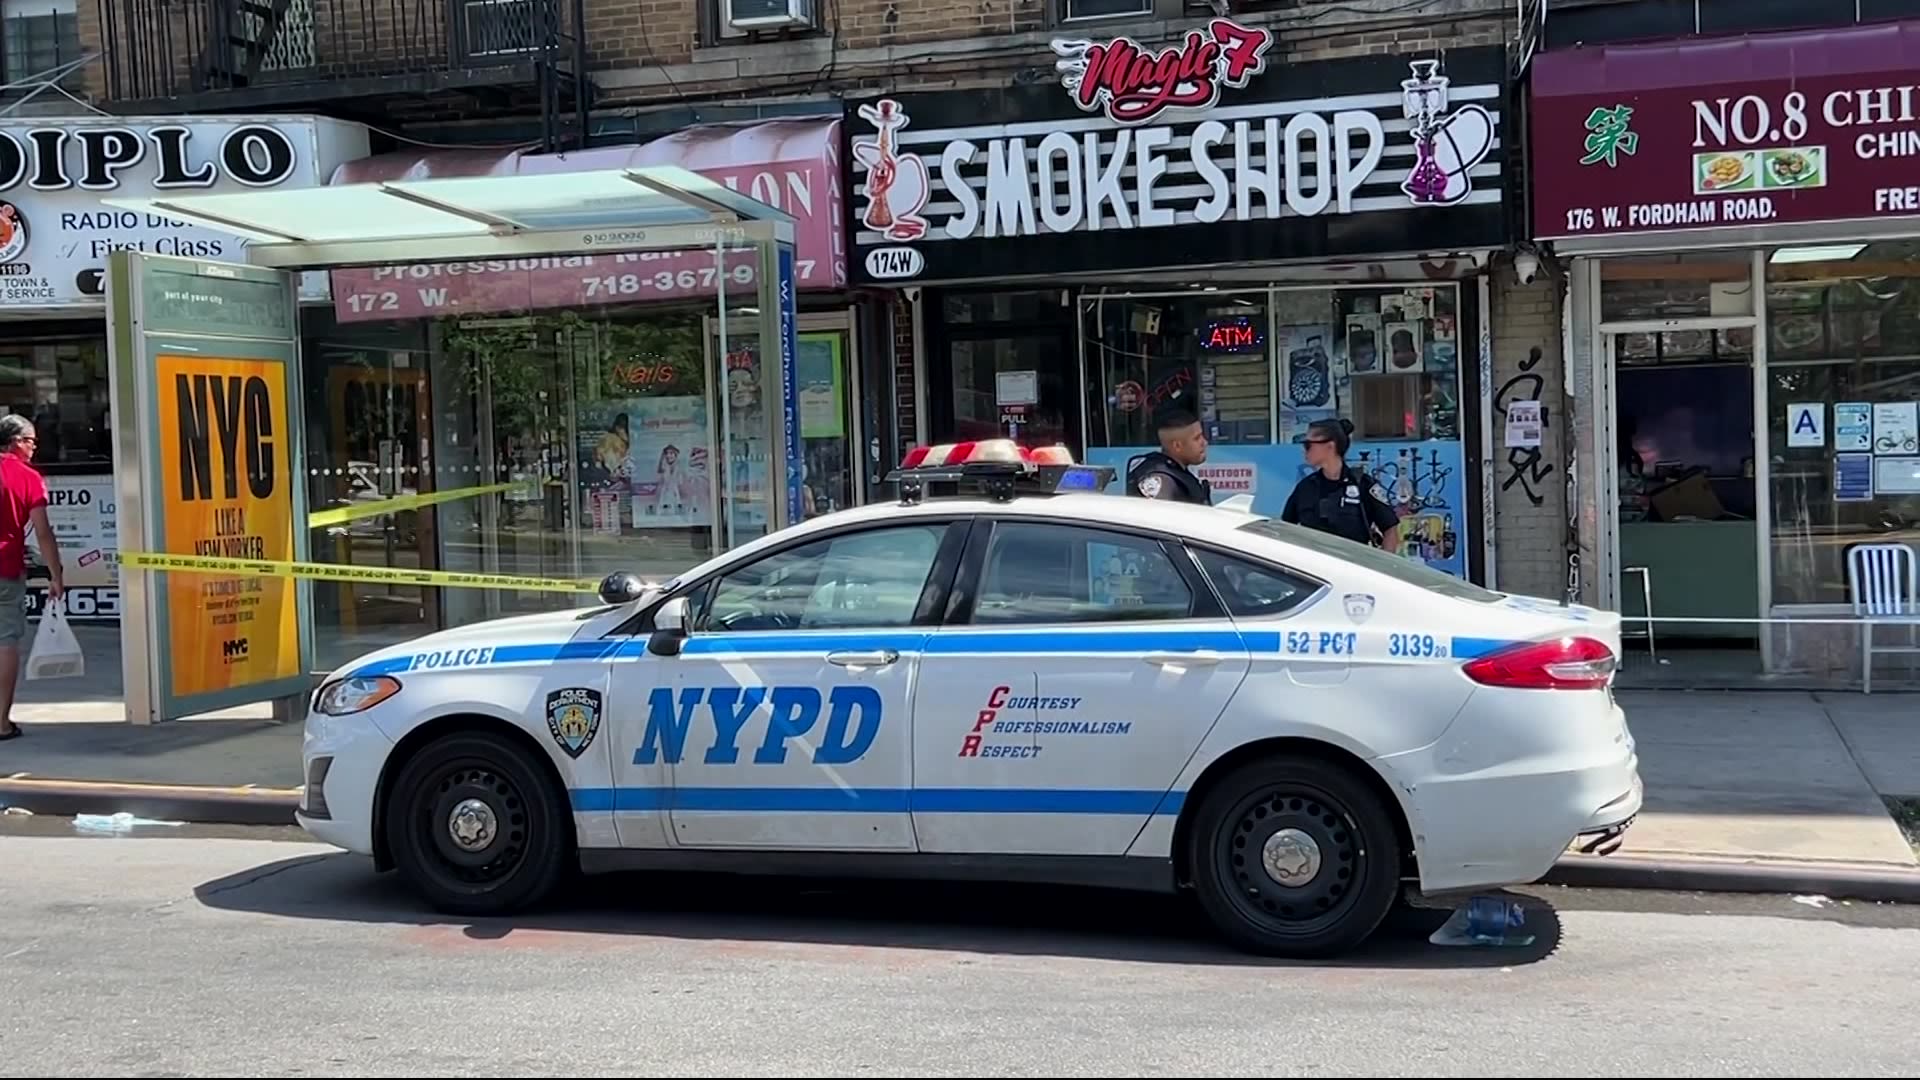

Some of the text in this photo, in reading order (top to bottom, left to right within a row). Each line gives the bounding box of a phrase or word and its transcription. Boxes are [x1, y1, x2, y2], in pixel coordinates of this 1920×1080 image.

[1072, 18, 1270, 118] Magic 7
[1691, 84, 1920, 150] NO.8 CHI
[1578, 103, 1640, 169] 第
[940, 110, 1386, 239] SMOKE SHOP
[1875, 187, 1920, 212] FRE
[61, 213, 138, 230] RADIO
[1565, 196, 1778, 231] 176 W. FORDHAM ROAD.
[156, 236, 223, 257] Class
[870, 251, 914, 276] 174W
[5, 277, 49, 288] TOWN &
[7, 288, 55, 299] SERVICE
[346, 292, 399, 313] 172
[419, 288, 460, 308] W.
[1209, 327, 1253, 348] ATM
[781, 311, 792, 400] Fordham
[609, 362, 673, 385] Nails
[1001, 414, 1028, 424] PULL
[1794, 408, 1818, 435] A
[175, 373, 274, 502] NYC
[785, 407, 795, 460] Road
[1197, 467, 1253, 479] BLUETOOTH
[1210, 480, 1250, 491] EAKERS
[215, 507, 247, 537] LIKE A
[223, 637, 249, 657] NYC
[1287, 631, 1448, 658] 52 PCT 3139 20
[410, 647, 494, 671] POLICE
[560, 689, 588, 698] POLICE
[988, 686, 1082, 709] COURTESY
[632, 686, 883, 764] NYPD
[971, 710, 1132, 734] PROFESSIONALISM
[958, 735, 1043, 758] RESPECT
